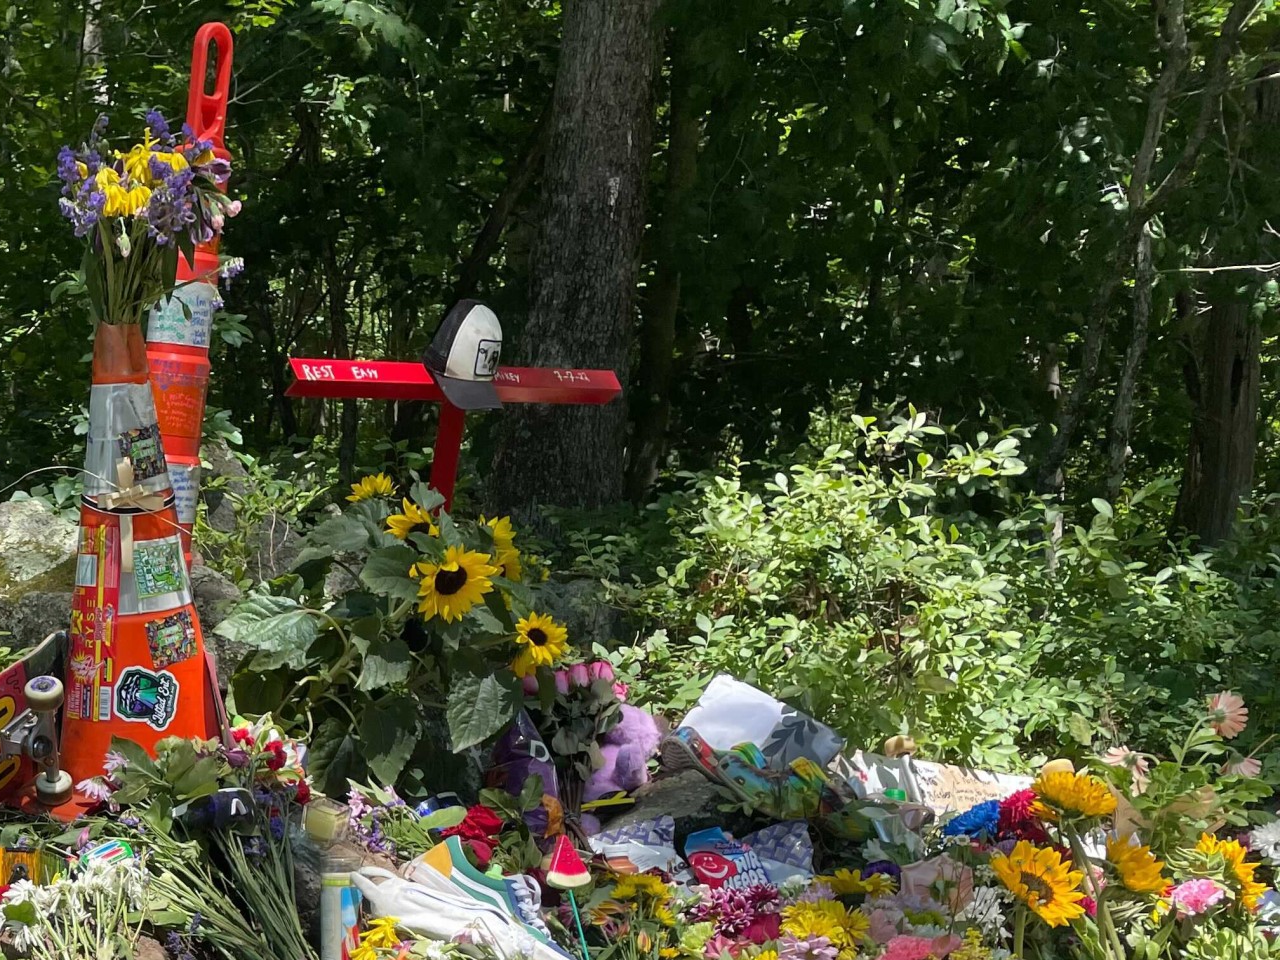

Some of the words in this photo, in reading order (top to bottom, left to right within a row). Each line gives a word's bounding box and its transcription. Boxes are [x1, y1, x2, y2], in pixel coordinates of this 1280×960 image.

[302, 364, 335, 380] REST
[84, 598, 96, 648] RYSE
[151, 695, 167, 725] Lifted
[732, 850, 762, 874] AIR
